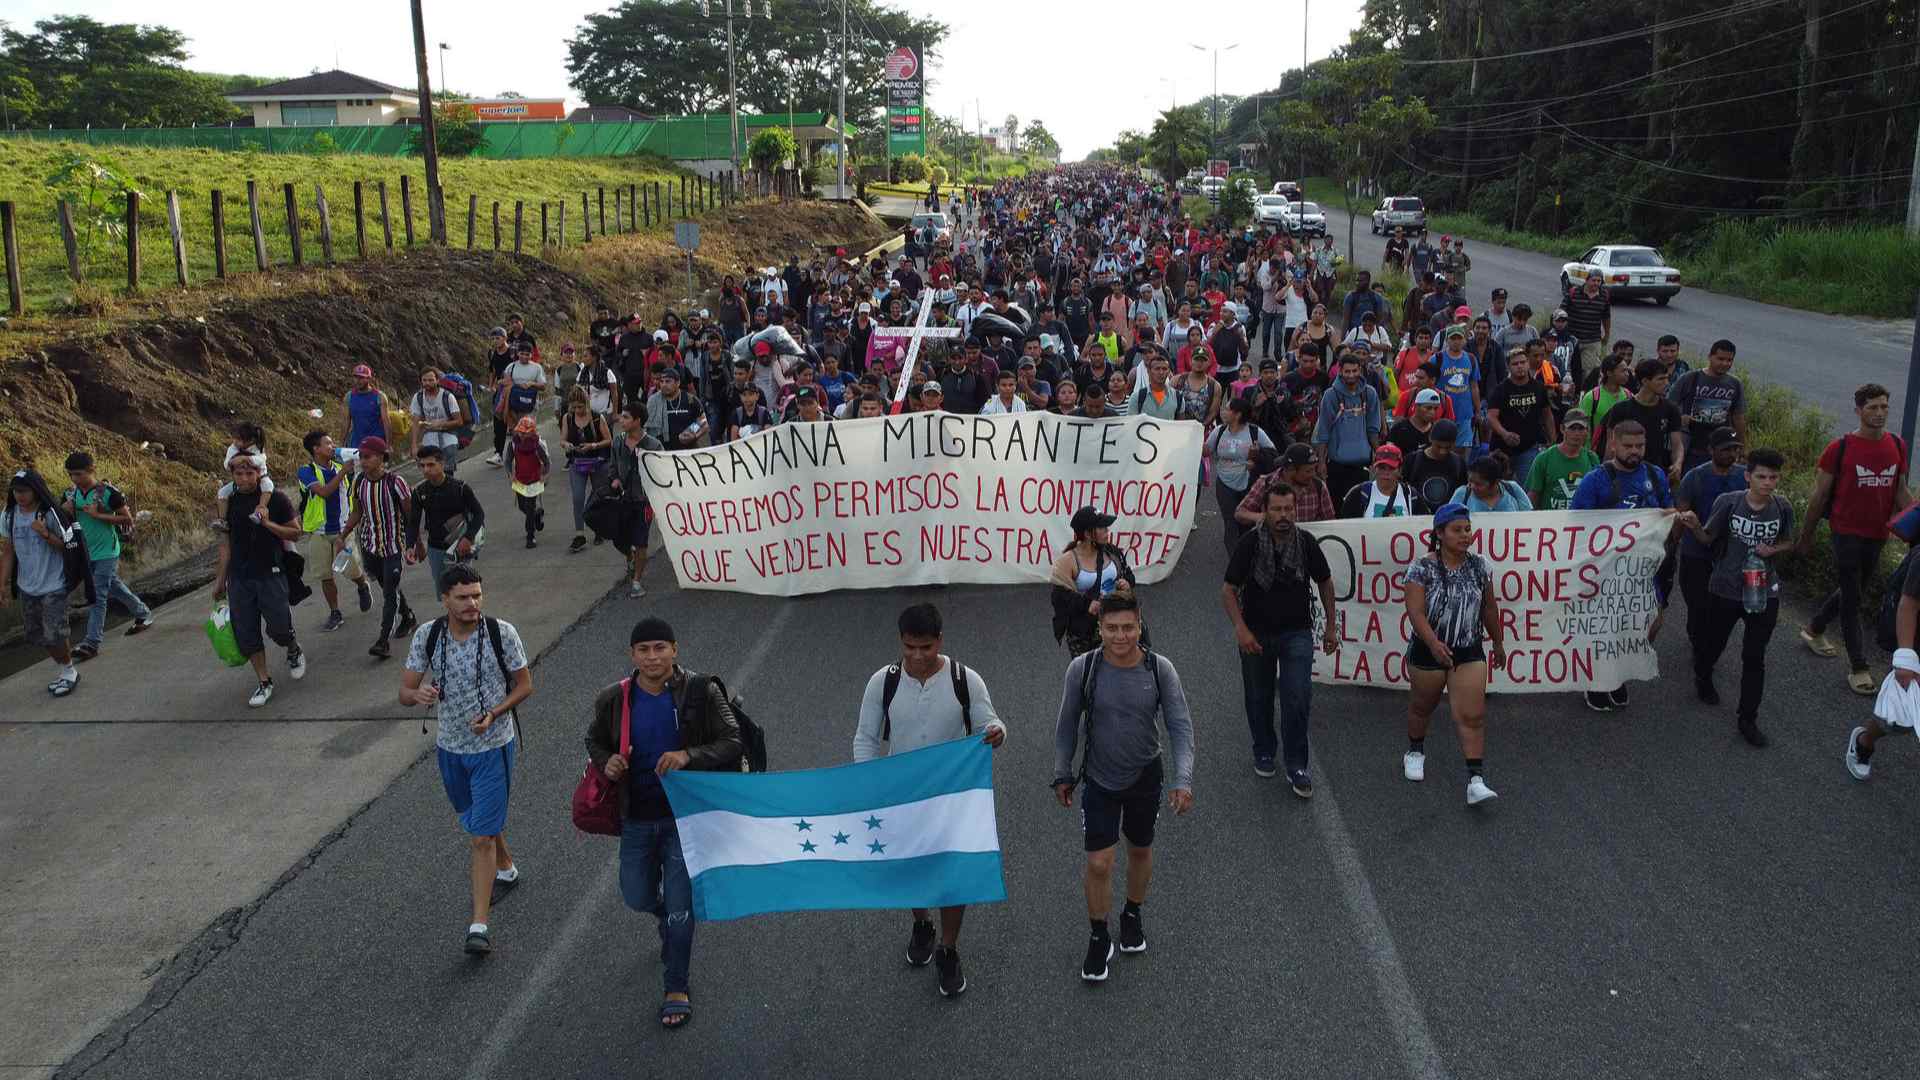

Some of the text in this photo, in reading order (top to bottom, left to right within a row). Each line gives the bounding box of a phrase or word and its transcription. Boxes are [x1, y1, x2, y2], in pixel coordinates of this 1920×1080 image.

[641, 413, 1161, 488] CARAVANA MIGRANTES
[665, 471, 1186, 537] QUEREMOS PERMISOS LA CONTENCIÓN
[1731, 516, 1779, 538] CUBS
[681, 549, 737, 583] QUE
[864, 530, 902, 567] ES
[920, 524, 1053, 566] NUESTRA
[1357, 571, 1406, 604] LOS
[1601, 577, 1653, 596] COLOMB
[1341, 609, 1383, 643] LA
[1556, 613, 1650, 636] VENEZUELA
[1334, 648, 1372, 683] LA
